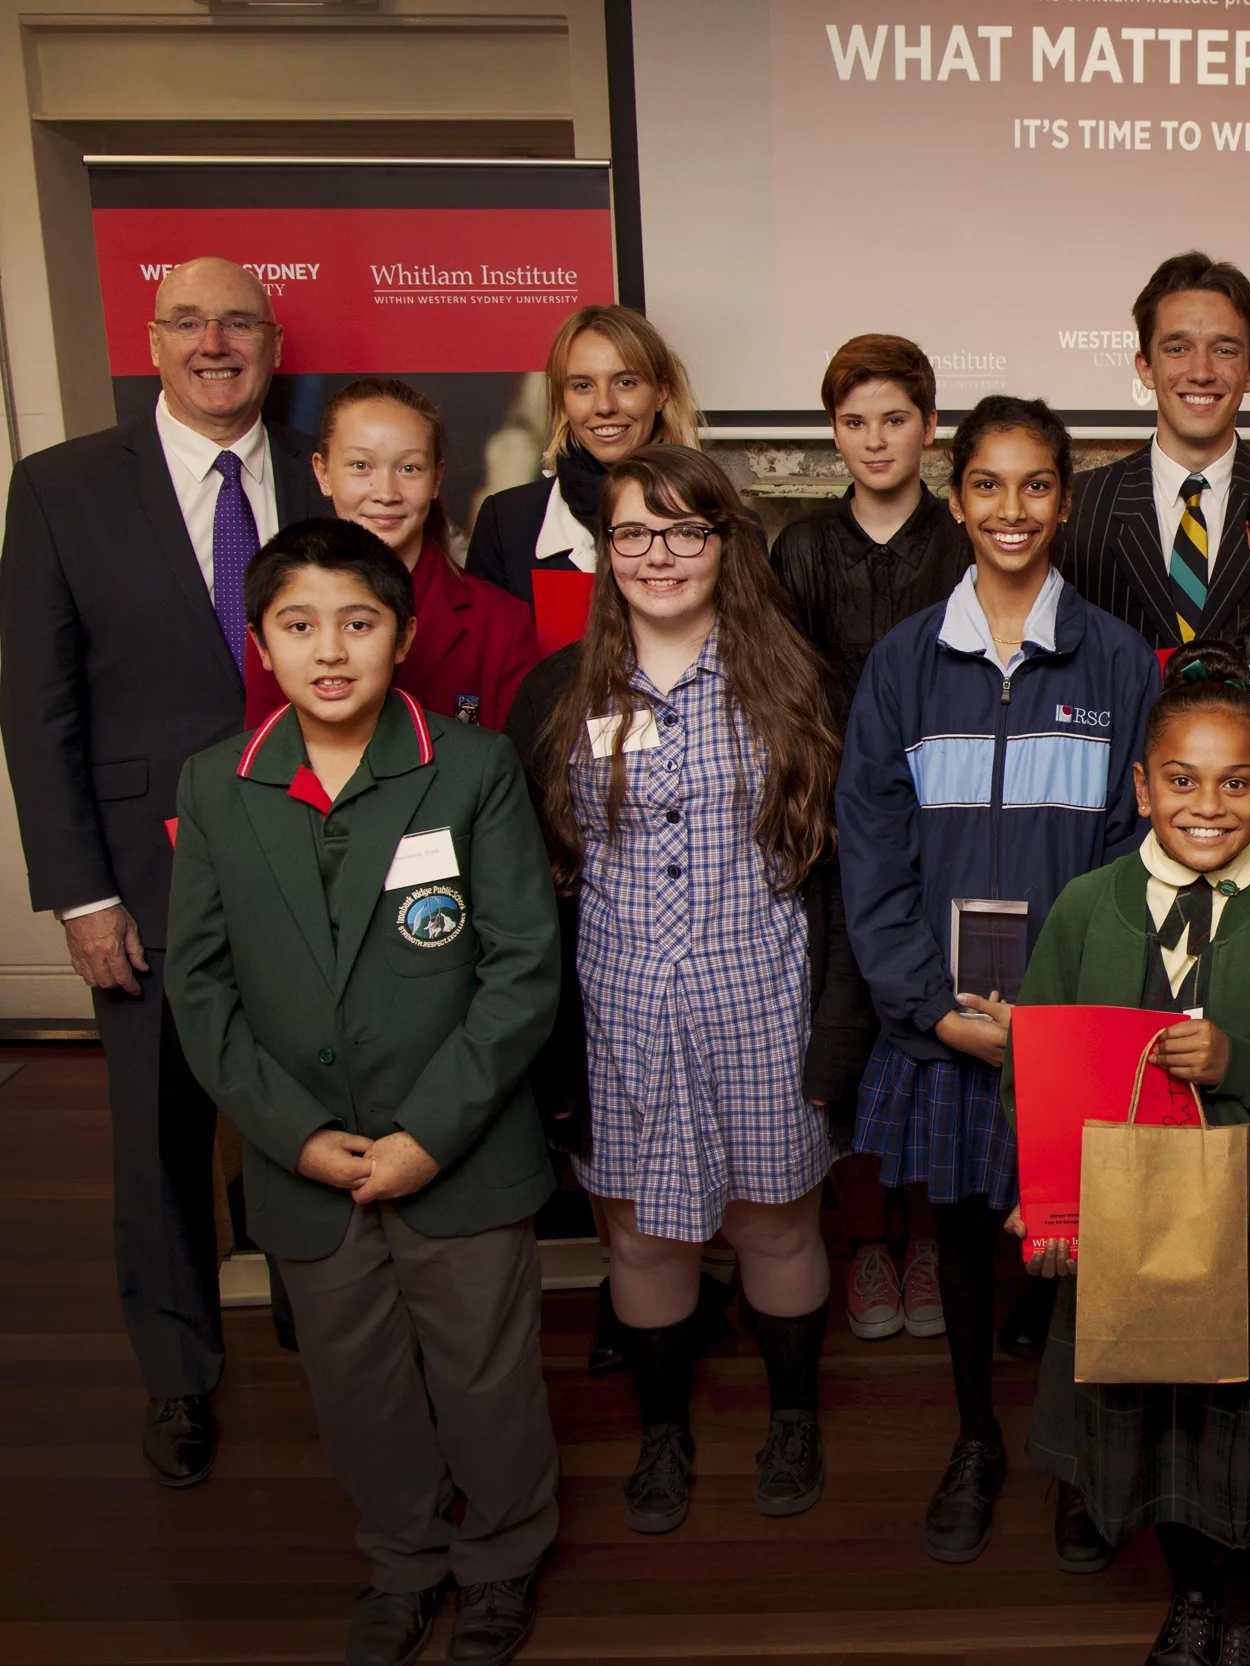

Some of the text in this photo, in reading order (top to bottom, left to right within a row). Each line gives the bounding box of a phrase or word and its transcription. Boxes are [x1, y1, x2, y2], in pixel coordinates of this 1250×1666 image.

[825, 24, 1013, 82] WHAT
[1013, 118, 1069, 149] IT'S
[1078, 119, 1152, 150] TIME
[1160, 120, 1202, 151] TO
[242, 263, 320, 280] SYDNEY
[370, 263, 578, 285] Whitlam Institute
[374, 295, 578, 304] WITHIN WESTERN SYDNEY UNIVERSITY
[926, 349, 1007, 370] nstitute
[1073, 707, 1110, 727] RSC
[411, 887, 433, 900] Ridge
[432, 885, 454, 896] Public
